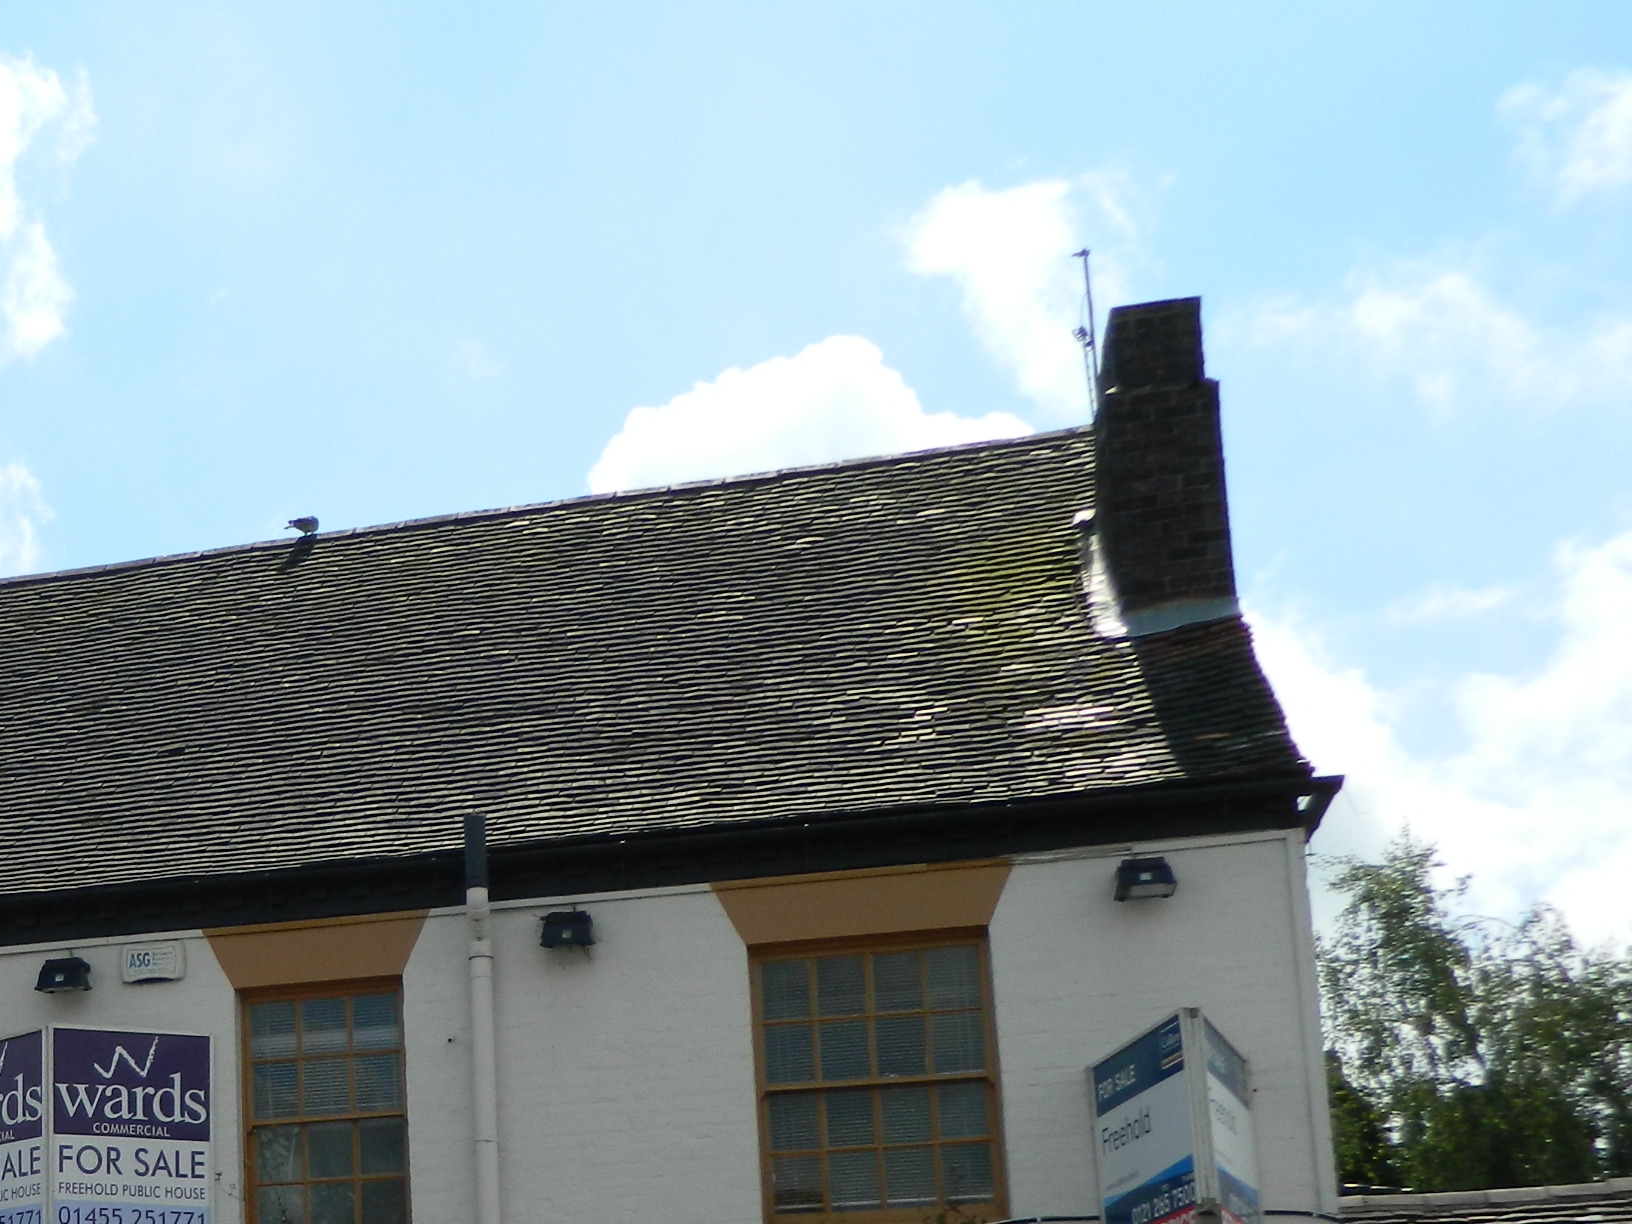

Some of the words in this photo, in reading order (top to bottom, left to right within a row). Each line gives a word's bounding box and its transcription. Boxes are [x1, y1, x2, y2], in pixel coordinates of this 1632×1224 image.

[129, 952, 151, 968] ASG
[1115, 1064, 1136, 1092] SALE
[55, 1072, 208, 1124] wards
[93, 1122, 170, 1137] COMMERCIAL
[1101, 1106, 1152, 1156] Freehold
[58, 1144, 123, 1176] FOR
[134, 1147, 206, 1179] SALE
[11, 1183, 42, 1200] HOUSE
[58, 1181, 119, 1196] FREEHOLD
[122, 1184, 161, 1199] PUBLIC
[165, 1186, 206, 1200] HOUSE
